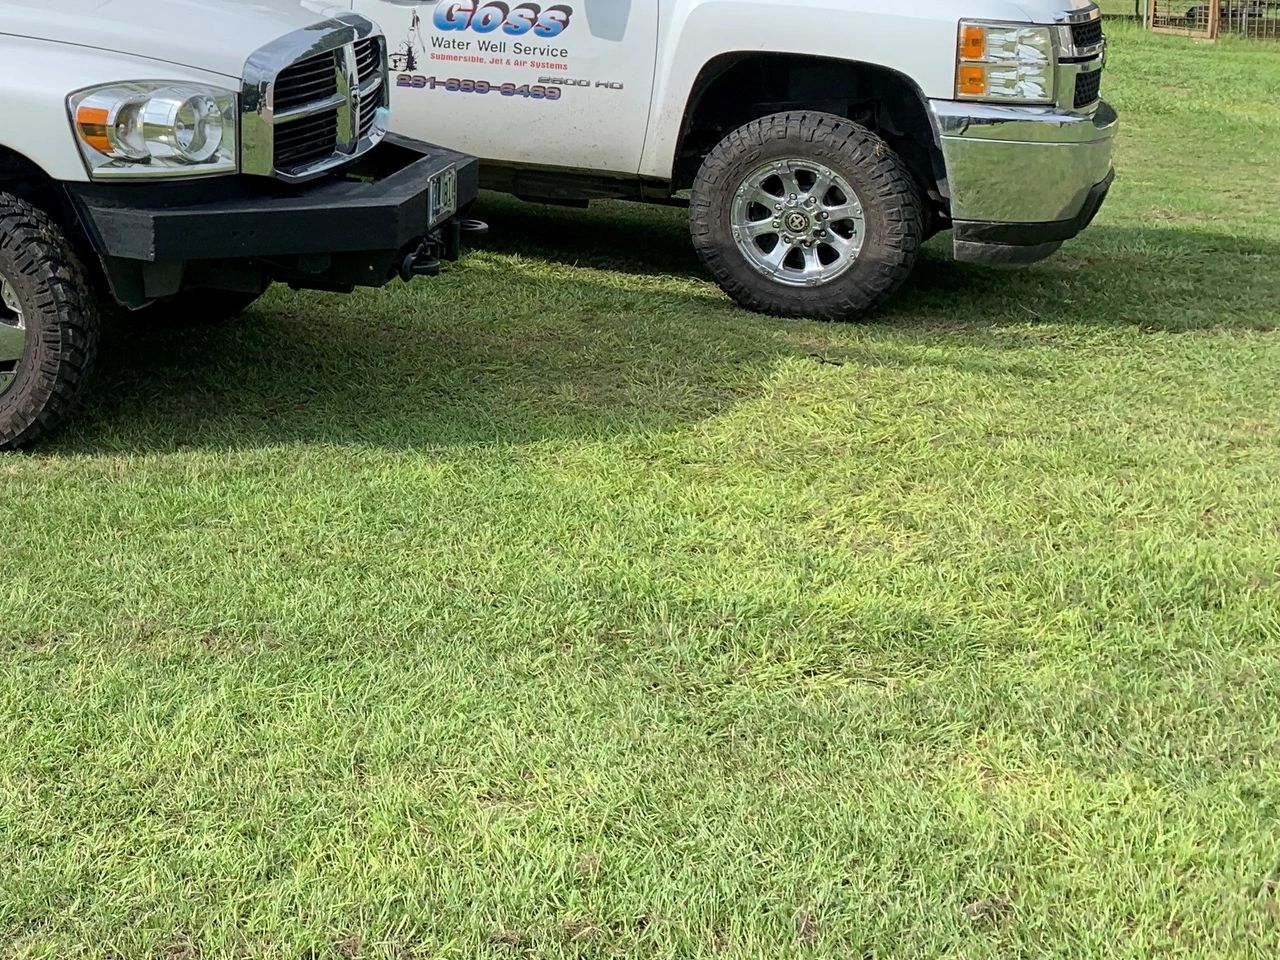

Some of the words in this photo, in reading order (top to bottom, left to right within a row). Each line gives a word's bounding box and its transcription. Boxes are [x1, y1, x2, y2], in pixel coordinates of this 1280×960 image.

[430, 36, 471, 50] Water
[477, 39, 506, 53] Well
[513, 42, 569, 58] Service
[430, 52, 487, 65] Submersible,
[489, 57, 504, 66] Jet
[505, 58, 511, 66] &
[513, 59, 528, 67] Air
[530, 60, 568, 71] Systems
